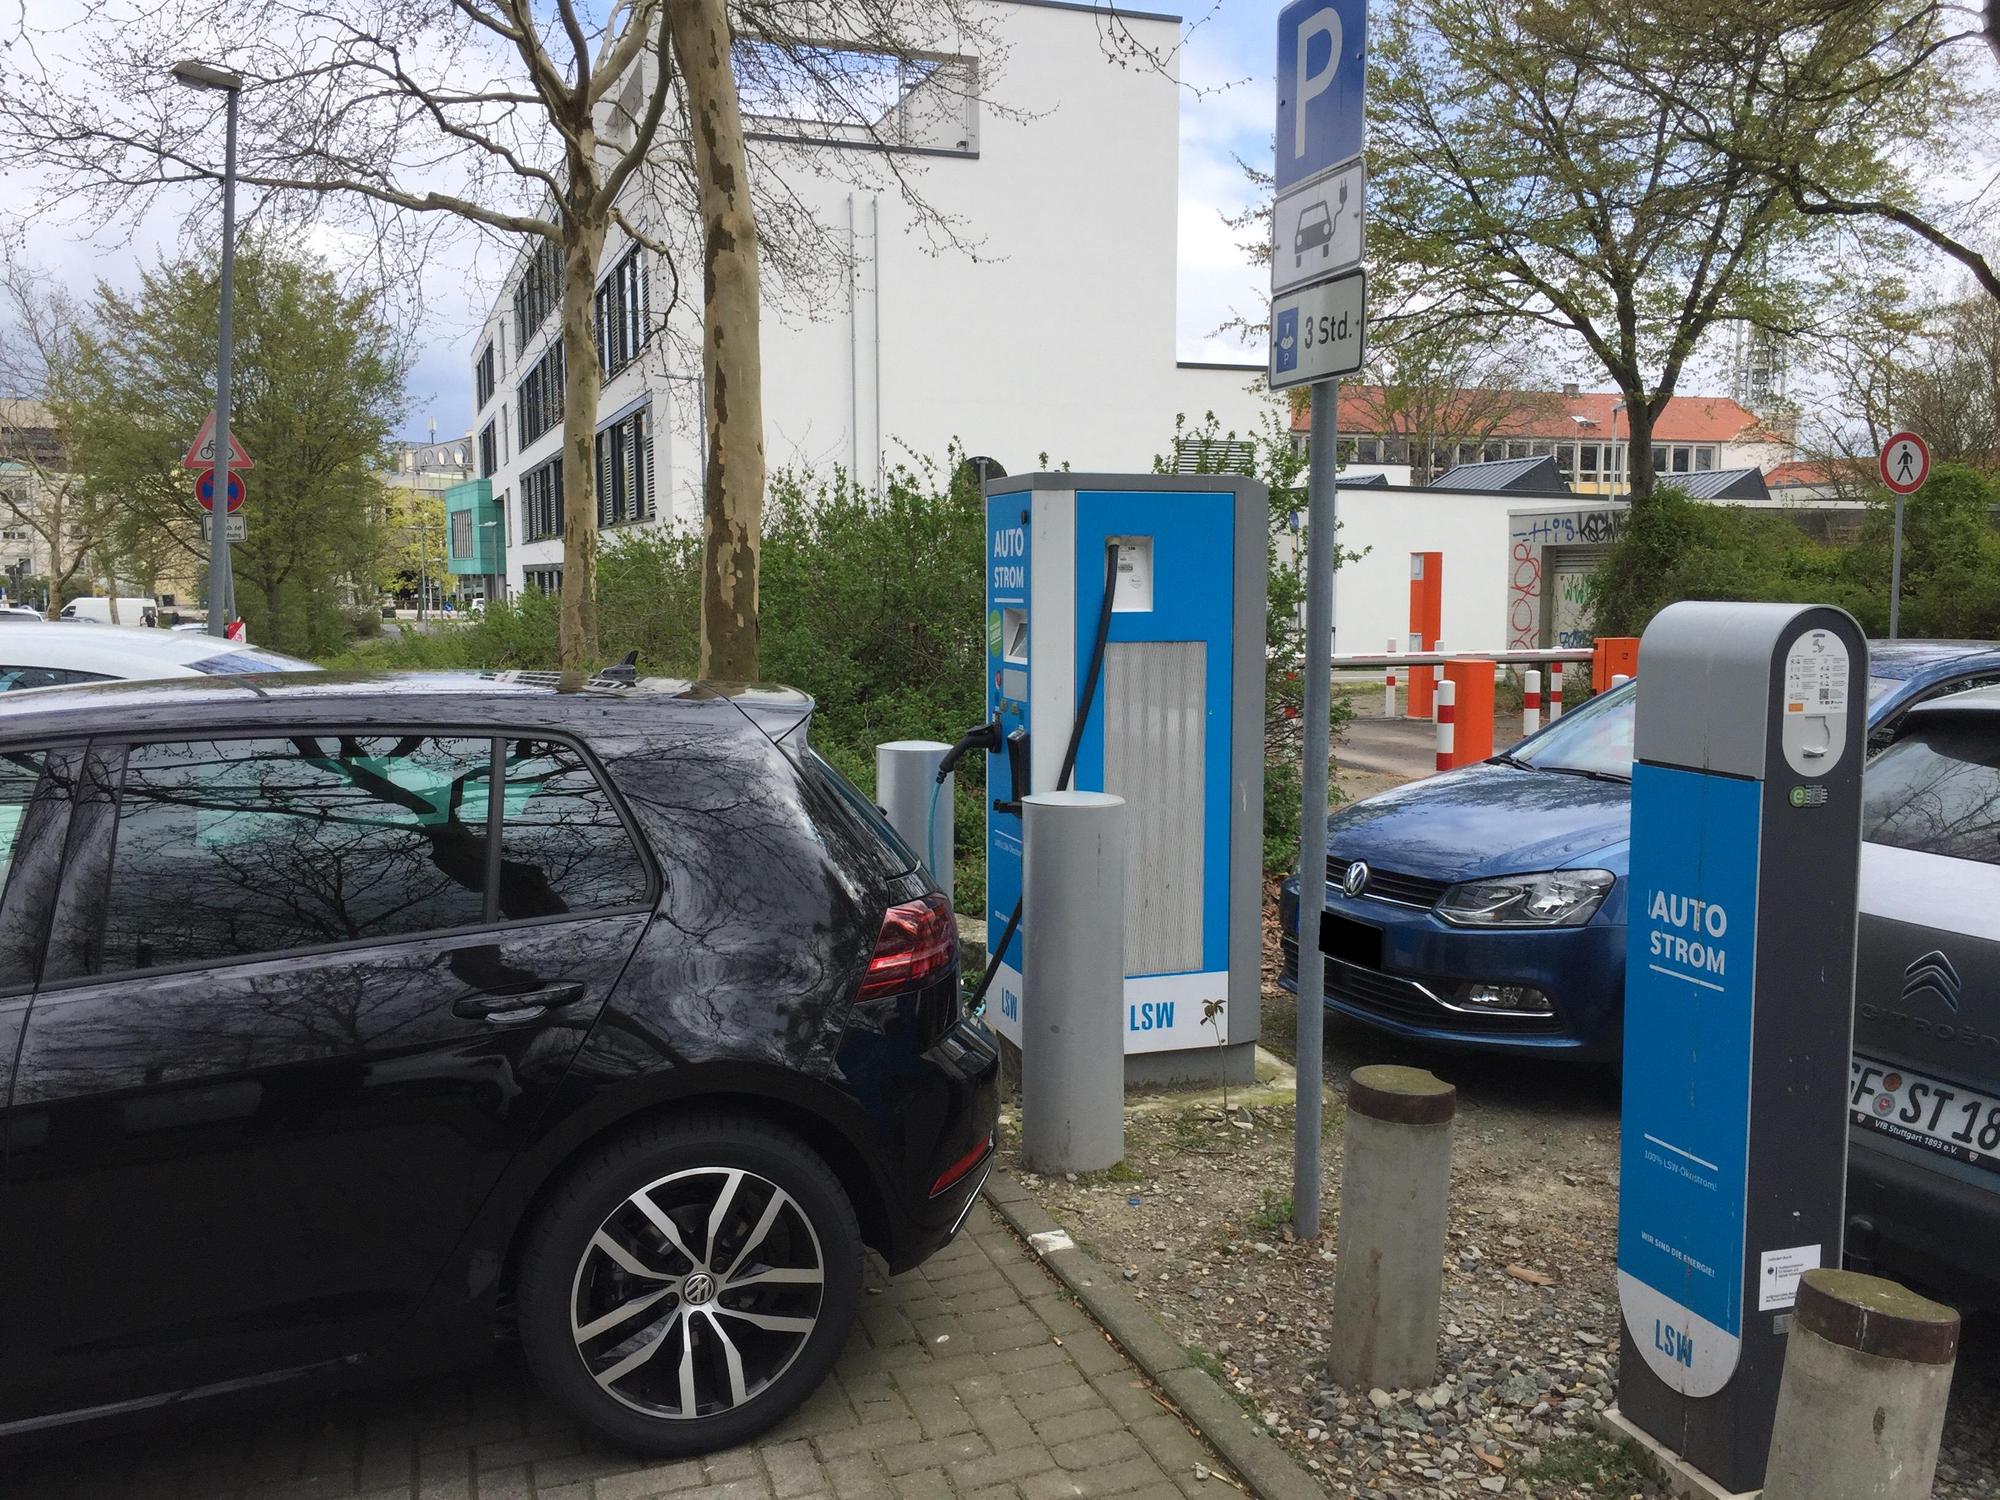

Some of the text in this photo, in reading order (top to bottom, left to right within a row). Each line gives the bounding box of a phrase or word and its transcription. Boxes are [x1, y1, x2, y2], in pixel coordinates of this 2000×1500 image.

[1295, 7, 1344, 160] P
[1304, 311, 1352, 349] 3 Std.
[994, 528, 1024, 558] AUTO
[994, 565, 1024, 590] STROM
[1650, 890, 1728, 938] AUTO
[1650, 930, 1726, 976] STROM
[1001, 987, 1018, 1022] LSW
[1130, 1001, 1175, 1032] LSW
[1899, 1082, 1955, 1131] ST
[1874, 1119, 1958, 1155] VfB Stuttgart 1893 e.V.
[1641, 1231, 1716, 1278] WIR SIND DIE ENERGIE!
[1655, 1318, 1694, 1369] LSW
